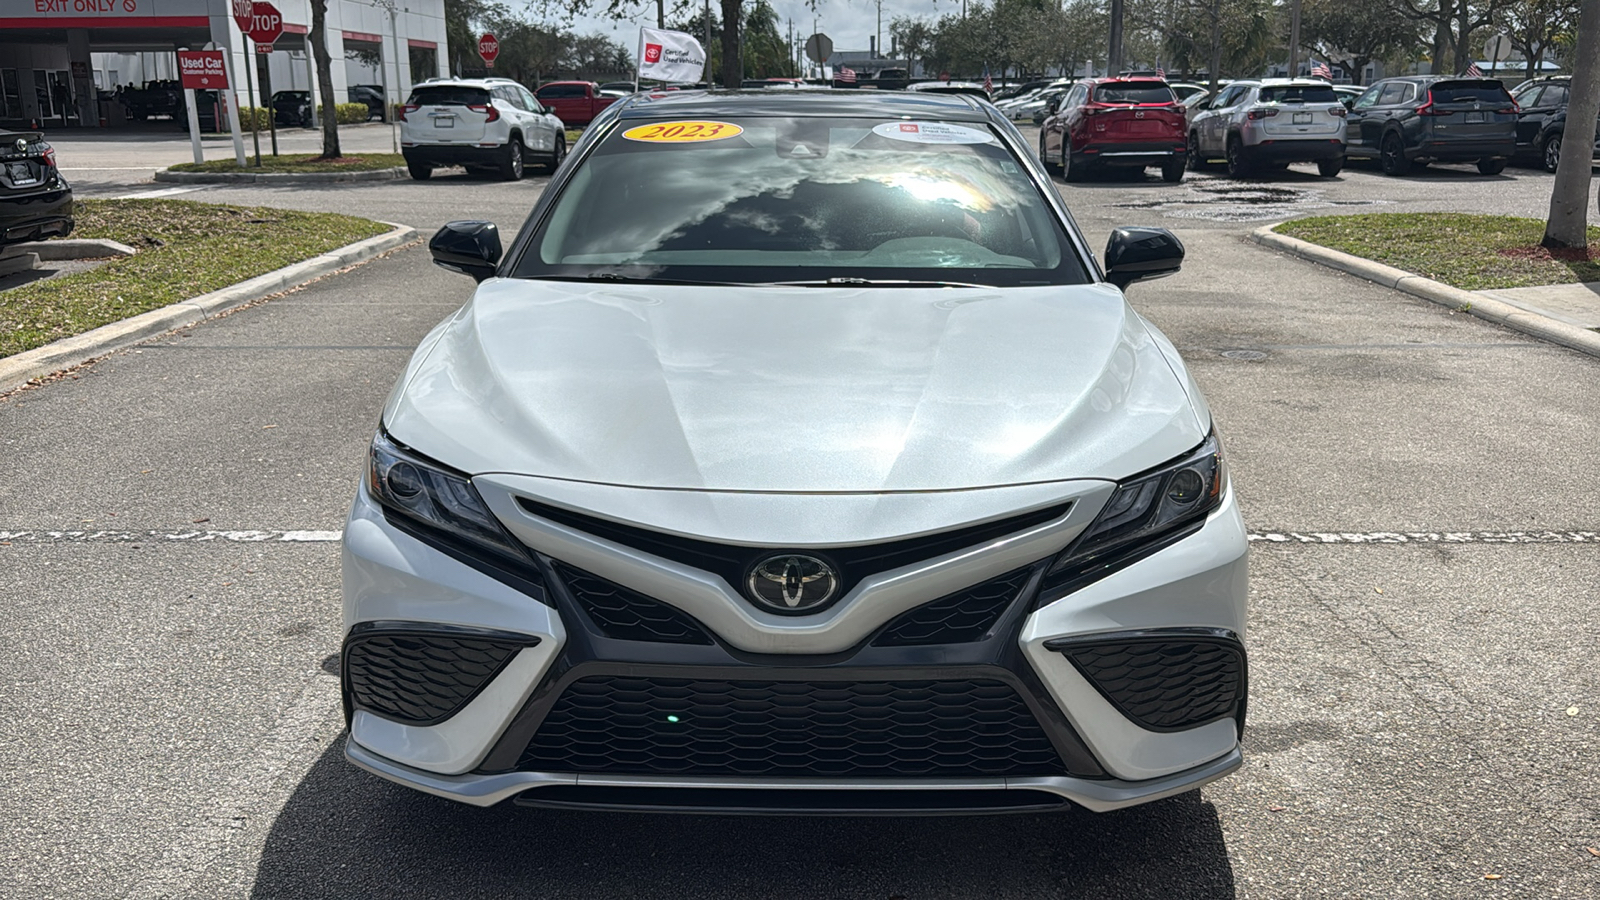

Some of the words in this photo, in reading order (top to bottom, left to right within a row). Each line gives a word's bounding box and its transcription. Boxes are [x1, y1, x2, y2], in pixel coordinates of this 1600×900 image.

[34, 0, 69, 12] EXIT
[73, 0, 116, 12] ONLY
[233, 0, 252, 18] STOP
[480, 42, 497, 53] STOP
[664, 49, 690, 57] Certified
[180, 57, 204, 69] Used
[205, 57, 222, 69] Car
[663, 56, 679, 64] Used
[679, 57, 703, 66] Vehicles
[640, 124, 725, 139] 2023
